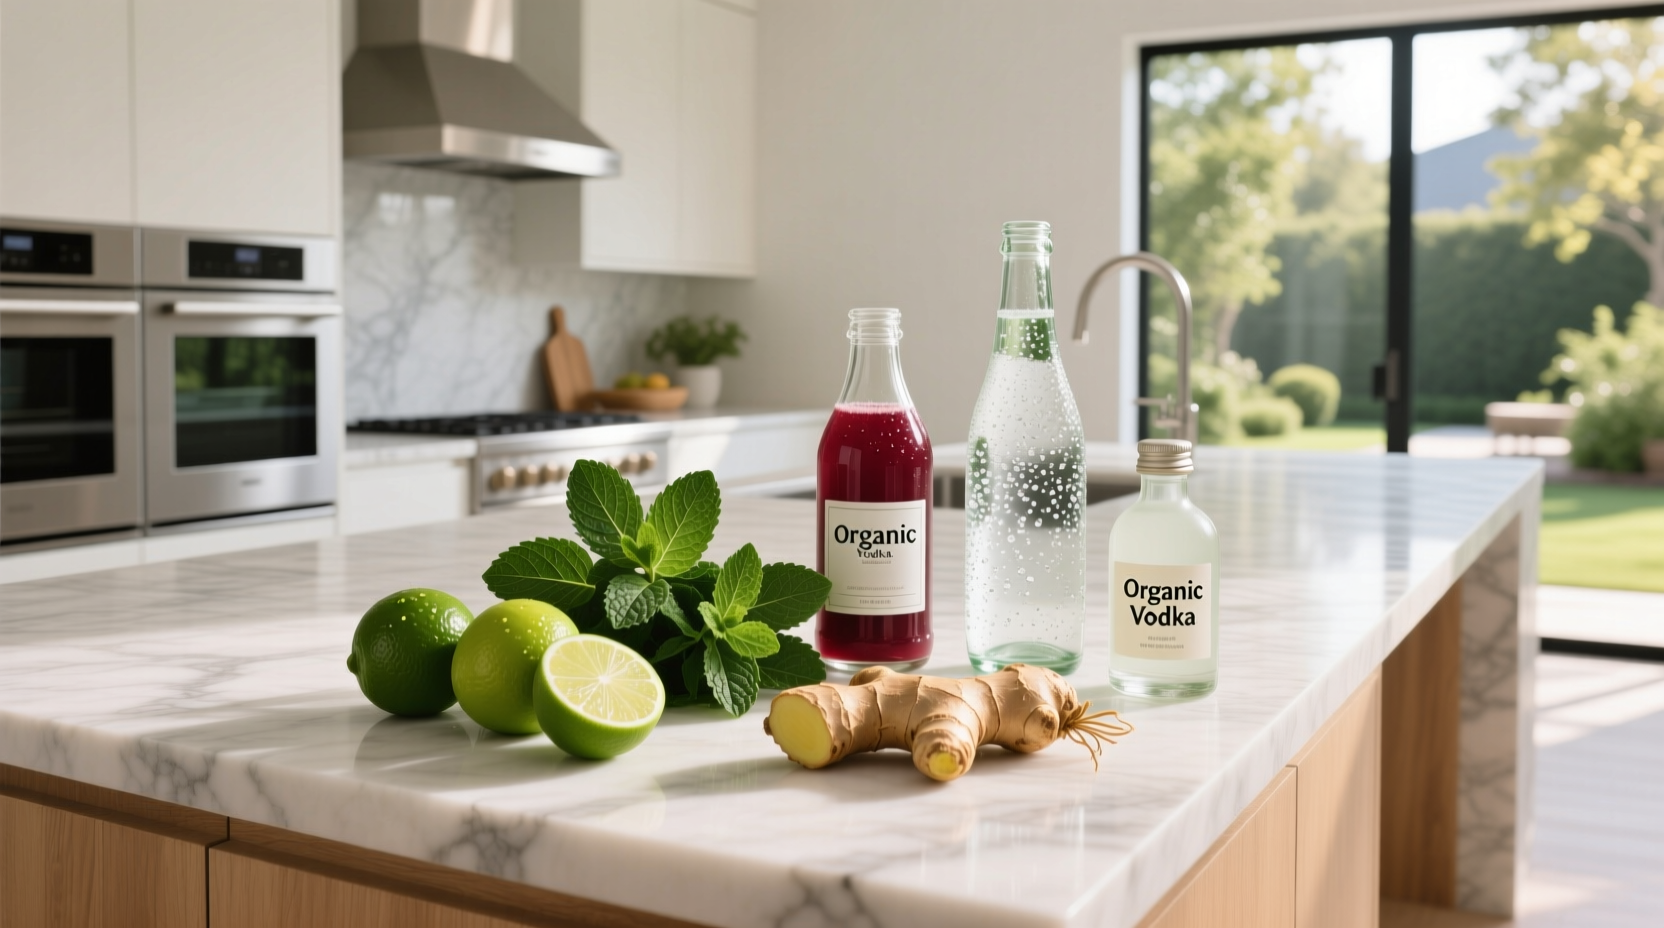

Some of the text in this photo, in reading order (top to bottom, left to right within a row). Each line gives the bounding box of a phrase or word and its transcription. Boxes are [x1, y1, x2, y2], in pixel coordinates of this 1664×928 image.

[834, 524, 917, 551] Organic
[1123, 578, 1204, 605] Organic
[1129, 604, 1196, 627] Vodka
